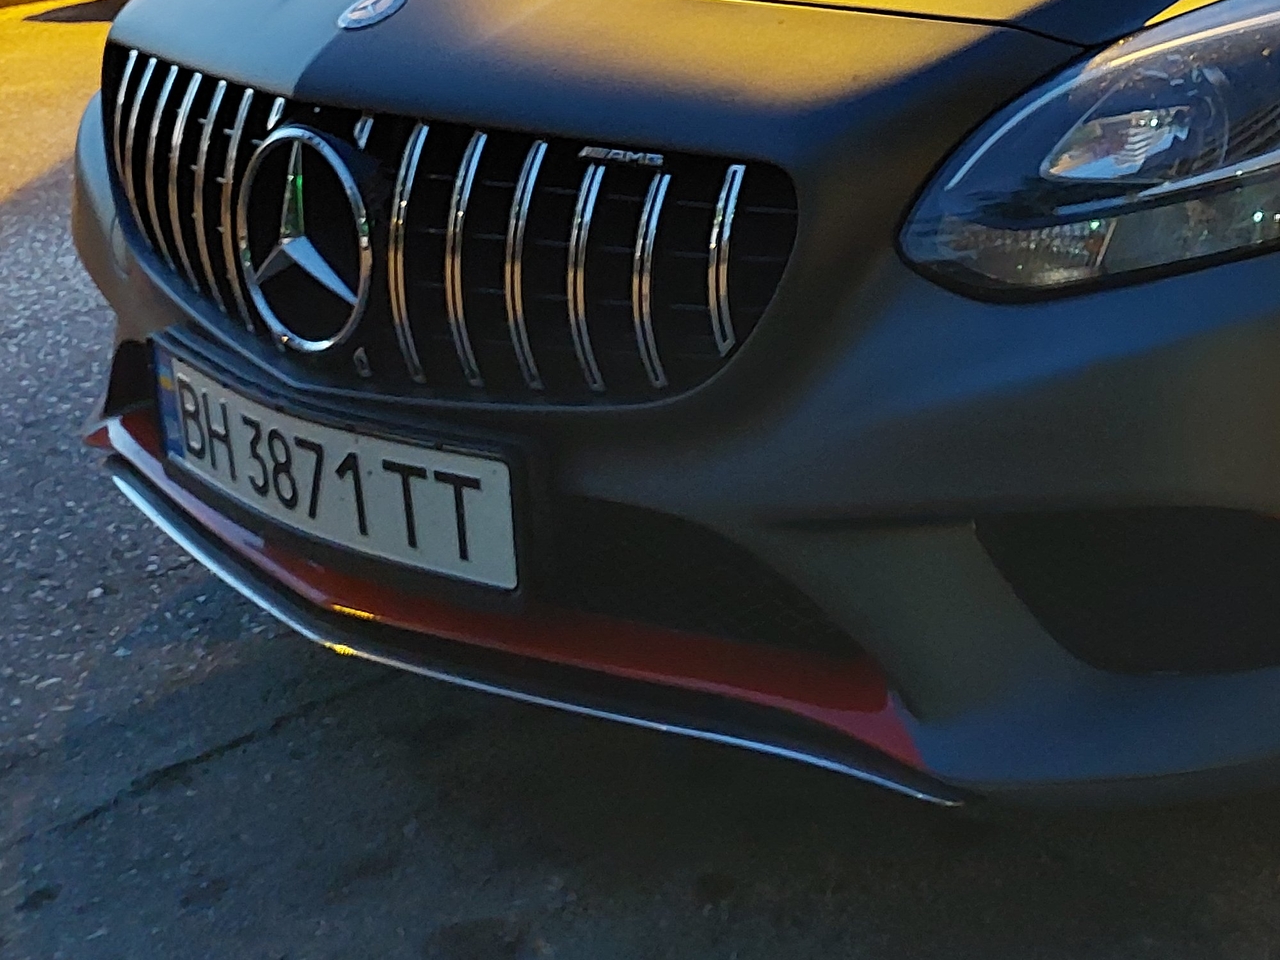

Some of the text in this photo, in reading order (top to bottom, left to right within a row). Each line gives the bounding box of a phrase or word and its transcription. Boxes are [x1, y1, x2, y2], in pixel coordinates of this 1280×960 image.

[605, 148, 664, 167] AMG
[242, 415, 369, 537] 3871
[382, 459, 482, 563] TT
